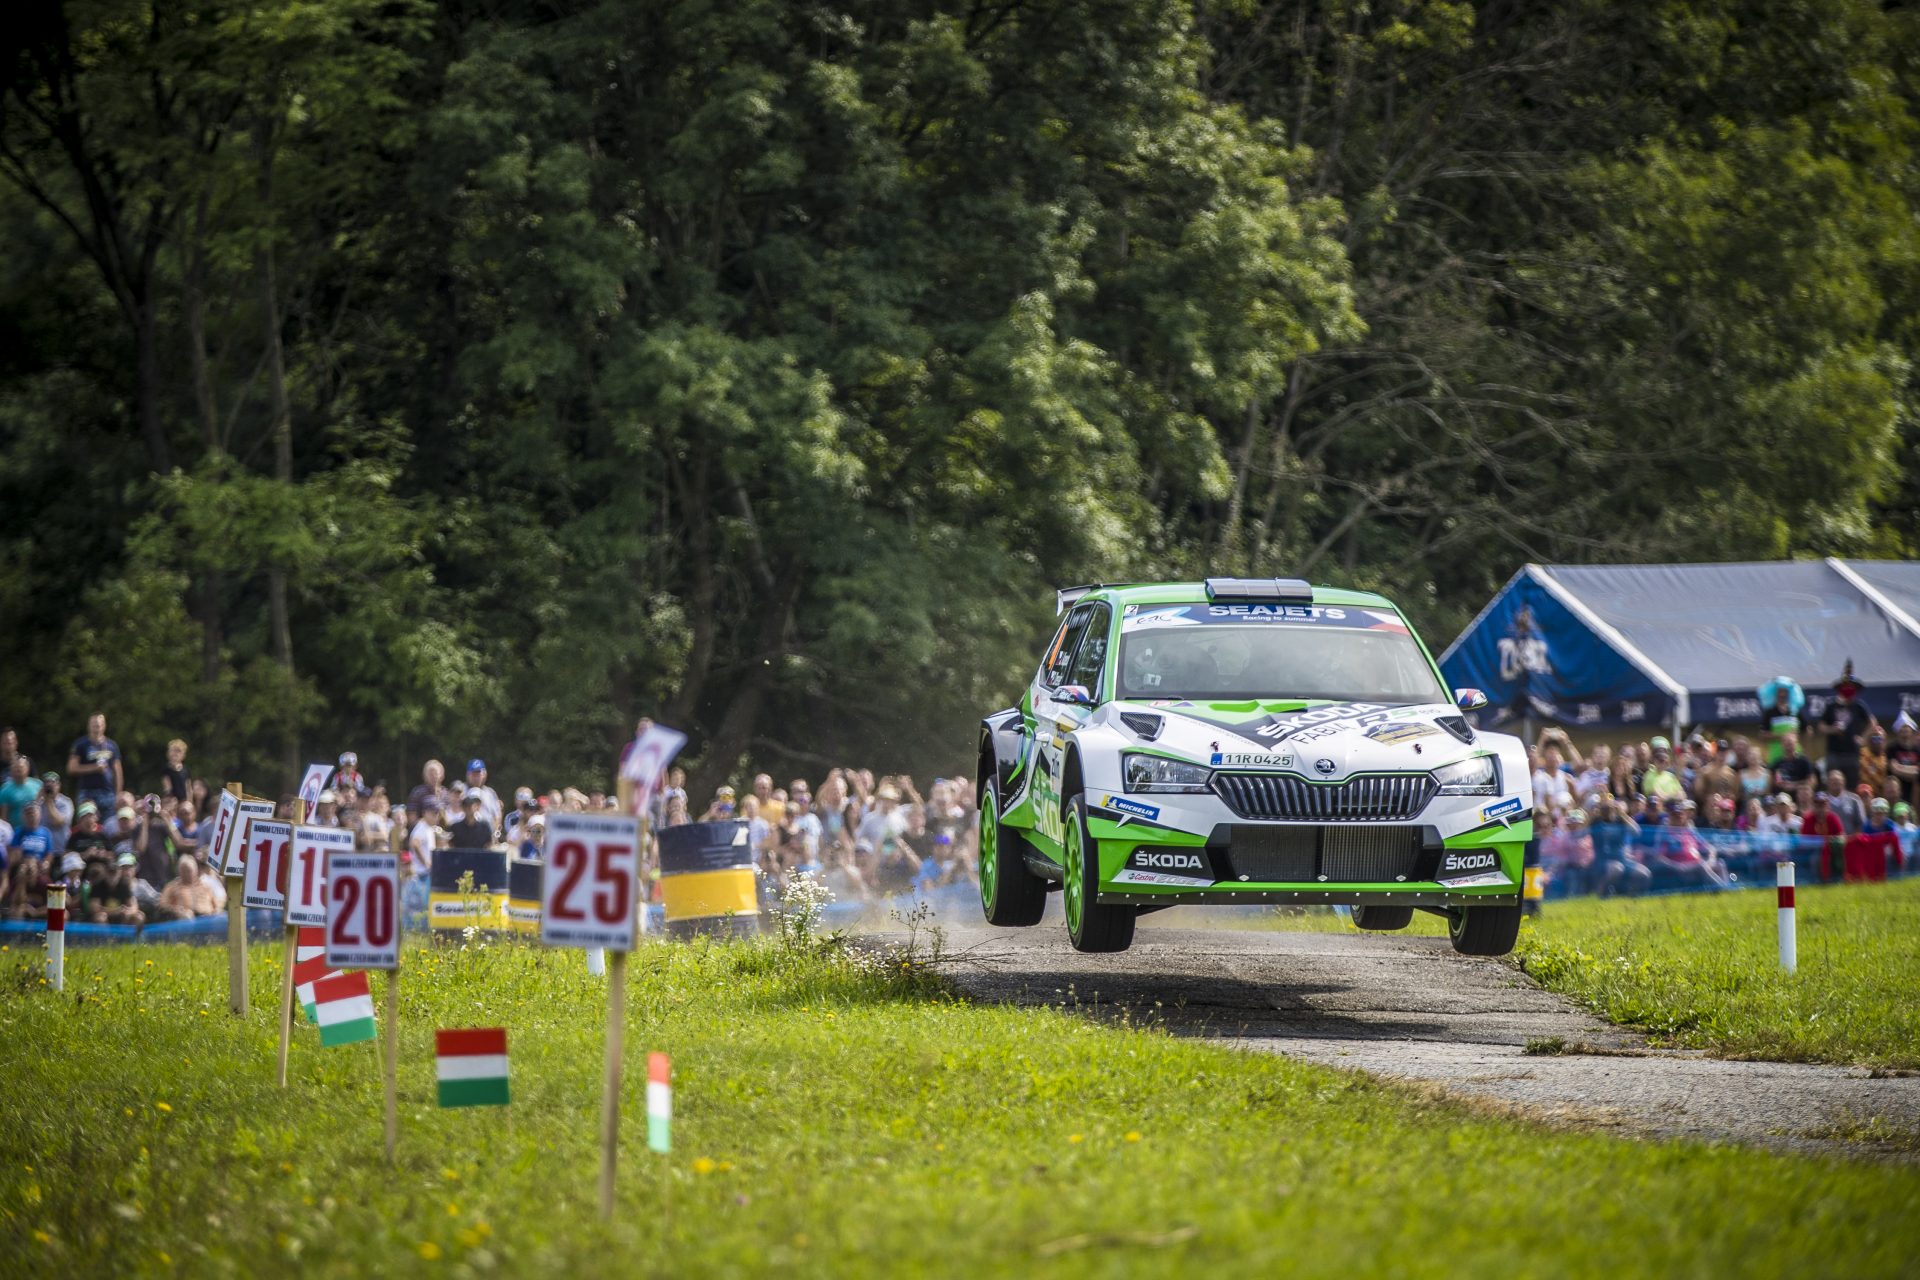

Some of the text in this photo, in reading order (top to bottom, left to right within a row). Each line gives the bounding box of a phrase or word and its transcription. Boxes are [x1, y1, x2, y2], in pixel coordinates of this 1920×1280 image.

[1208, 605, 1346, 619] SEAJETS
[1255, 702, 1388, 739] ŠKODA
[1290, 722, 1357, 745] FABIA
[1356, 707, 1418, 728] R5
[1226, 754, 1251, 764] 11R
[1254, 755, 1291, 766] 0425
[1118, 802, 1155, 817] MICHELIN
[1491, 802, 1518, 815] MICHELIN
[214, 808, 229, 856] 5
[1135, 850, 1203, 869] ŠKODA
[1446, 855, 1495, 870] ŠKODA
[549, 839, 632, 925] 25
[1134, 873, 1157, 882] Castrol
[331, 875, 394, 947] 20
